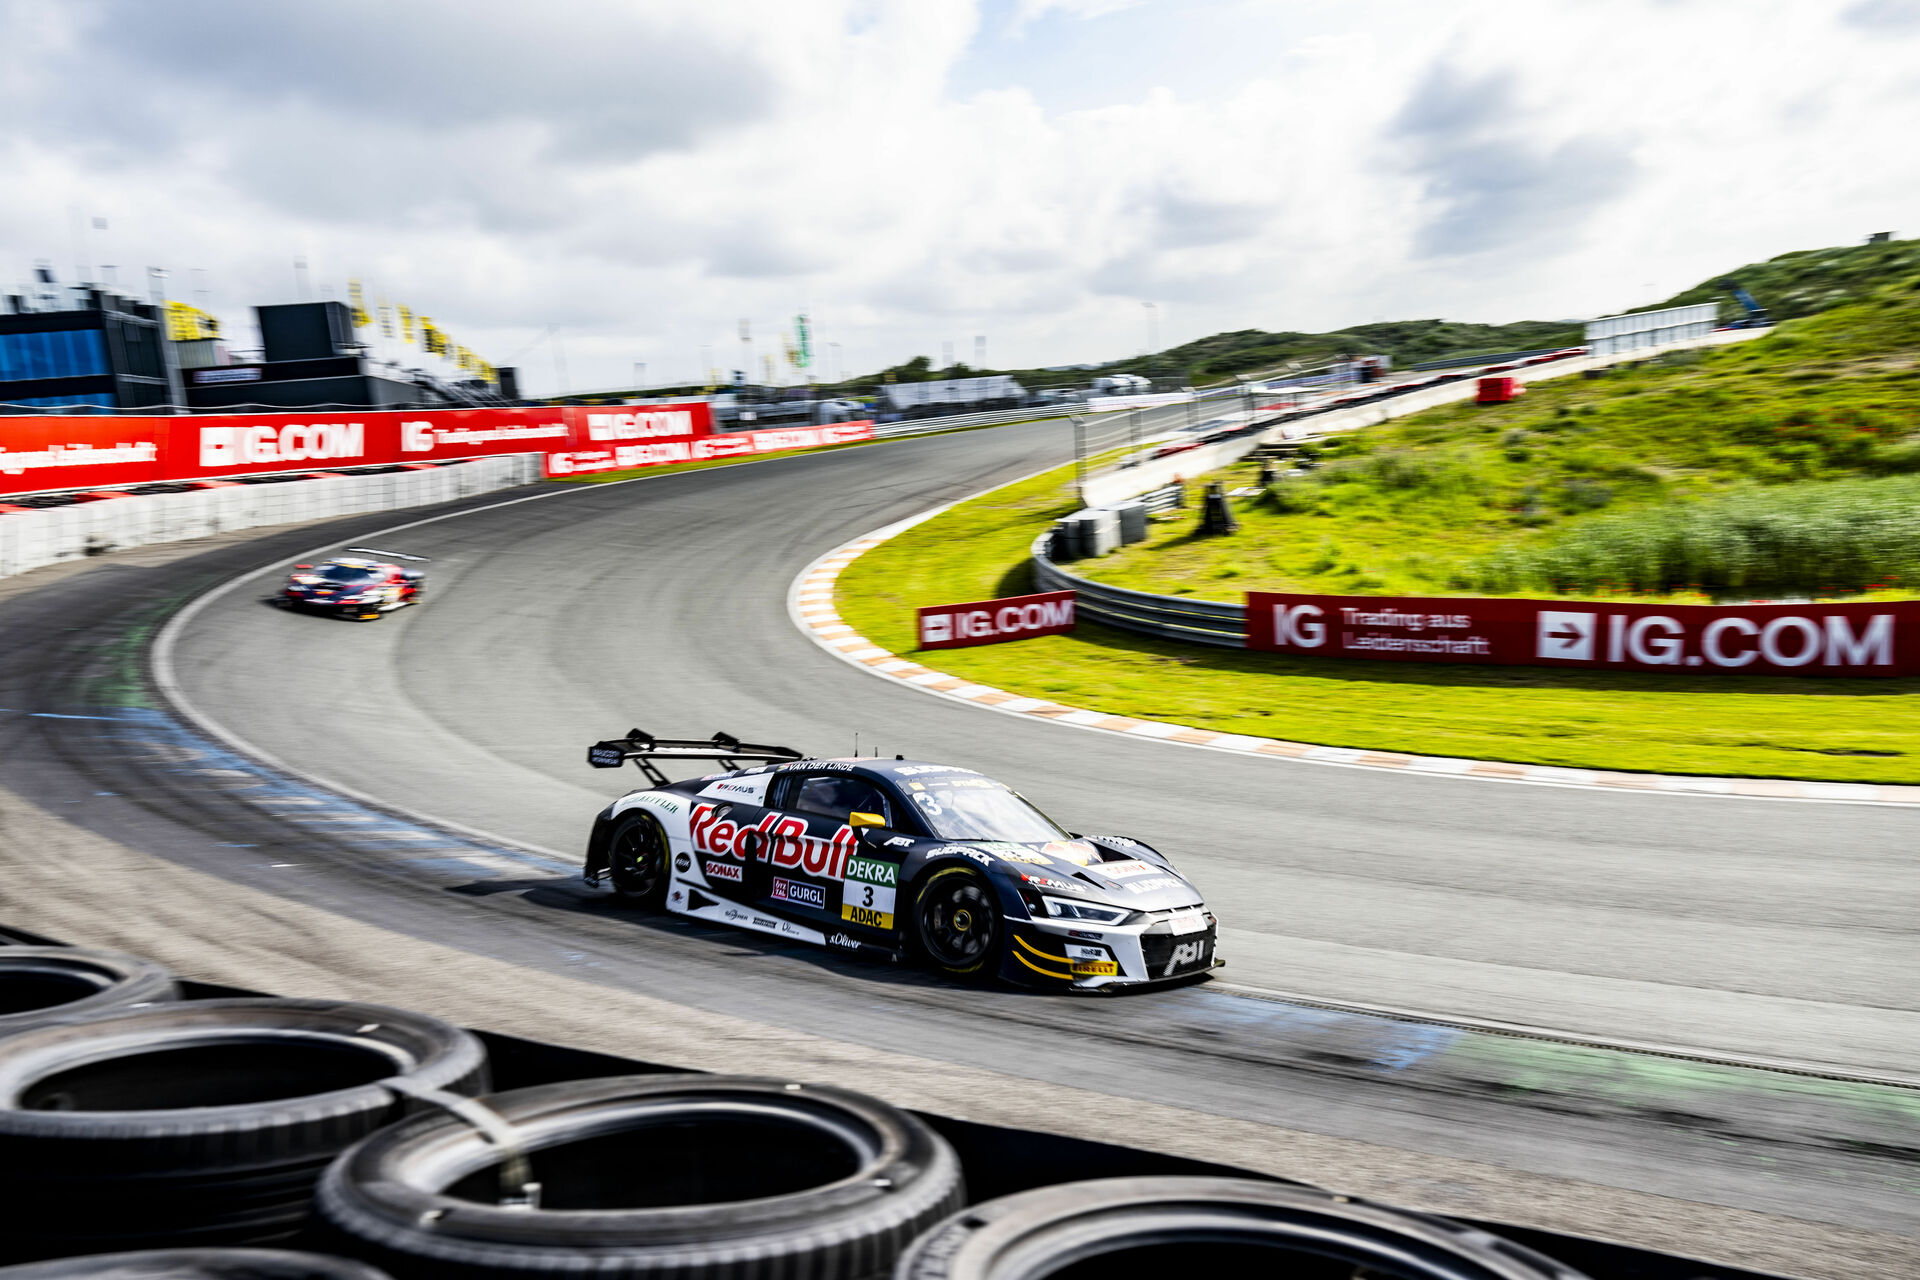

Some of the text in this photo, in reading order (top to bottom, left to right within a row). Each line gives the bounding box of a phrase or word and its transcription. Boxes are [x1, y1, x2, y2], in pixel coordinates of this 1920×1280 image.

[955, 600, 1074, 639] IG.COM
[1339, 607, 1472, 631] Trading aus
[1273, 604, 1895, 668] IG IG.COM
[789, 762, 856, 772] VAN DER LINDE
[912, 791, 943, 816] 3
[883, 836, 915, 848] ABT
[706, 863, 740, 879] SONAX
[846, 858, 897, 885] DEKRA
[789, 885, 823, 904] GURGL
[862, 885, 874, 908] 3
[850, 906, 883, 927] ADAC
